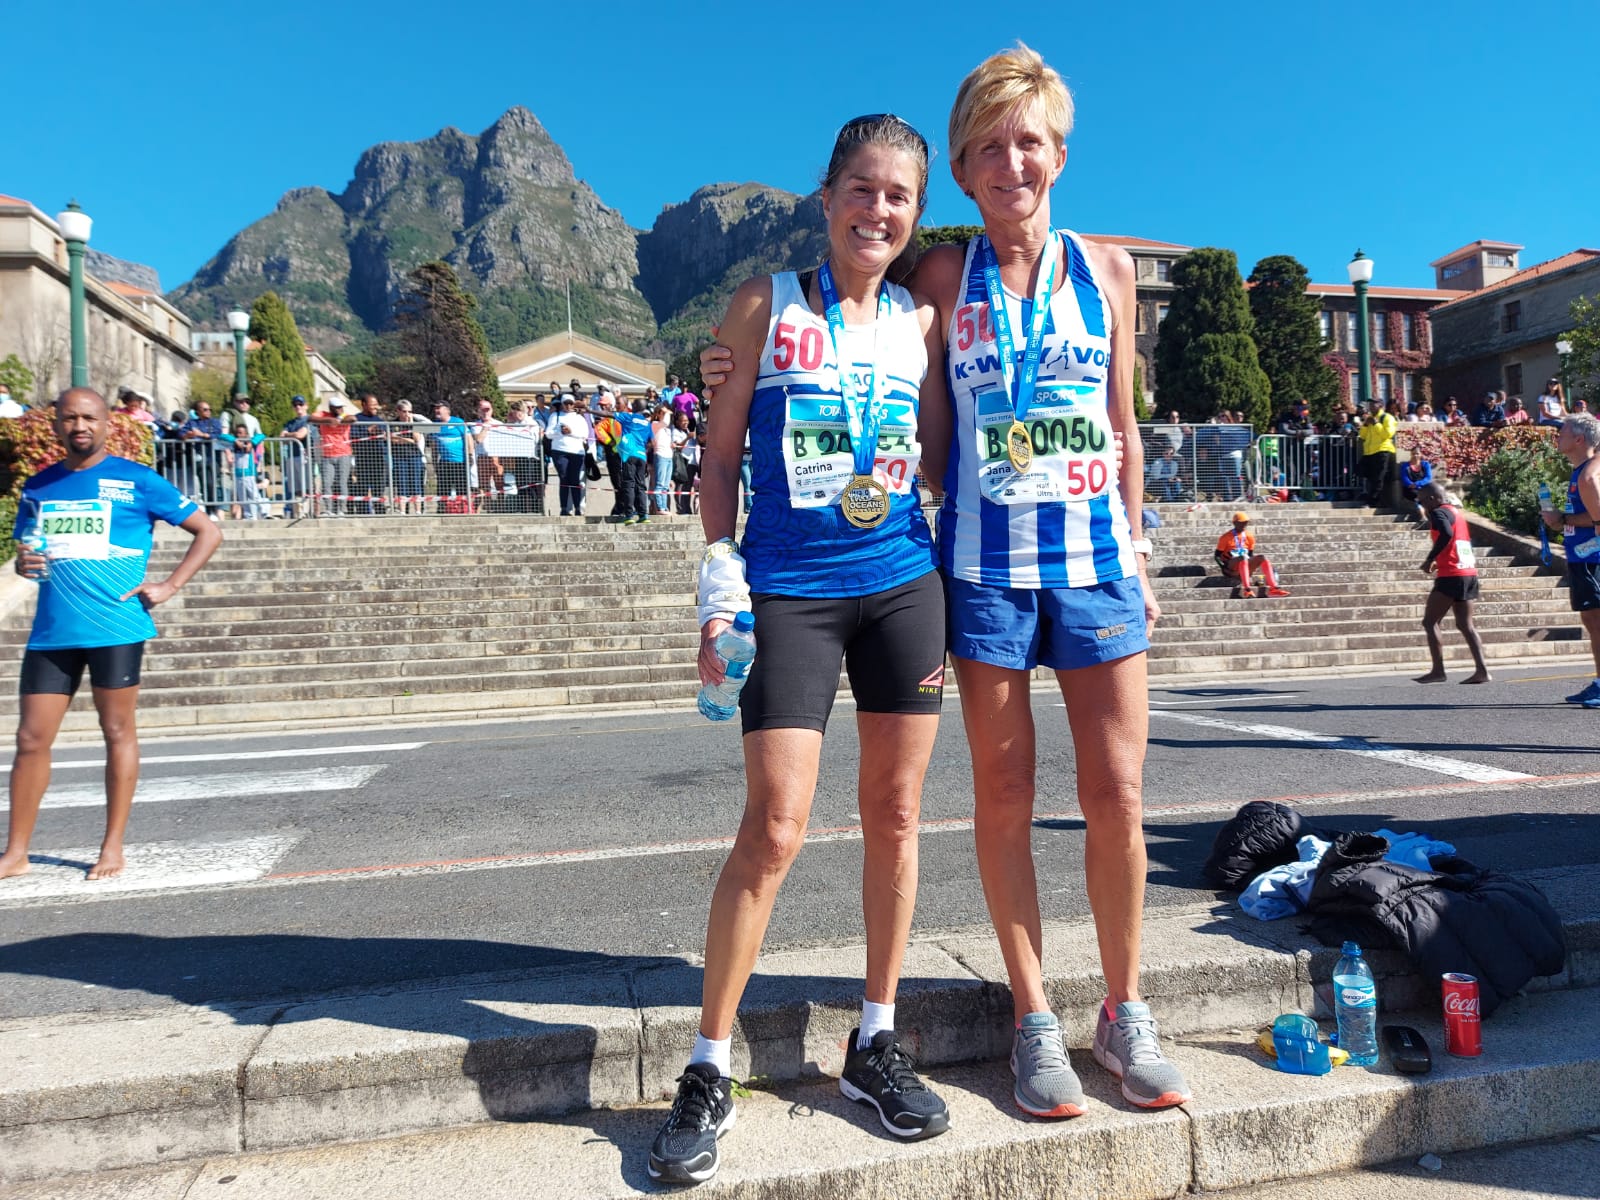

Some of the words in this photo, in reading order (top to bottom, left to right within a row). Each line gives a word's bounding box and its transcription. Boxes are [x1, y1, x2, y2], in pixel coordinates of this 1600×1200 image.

[957, 302, 996, 351] 50
[773, 323, 824, 370] 50
[794, 431, 807, 457] B
[987, 427, 1002, 458] B
[1024, 417, 1106, 456] 0050
[795, 462, 833, 476] Catrina
[873, 458, 907, 491] 50
[986, 466, 1011, 475] Jana
[1067, 459, 1107, 495] 50
[849, 501, 884, 509] OCEANS
[54, 517, 104, 534] 22183
[1444, 992, 1478, 1014] Coca
